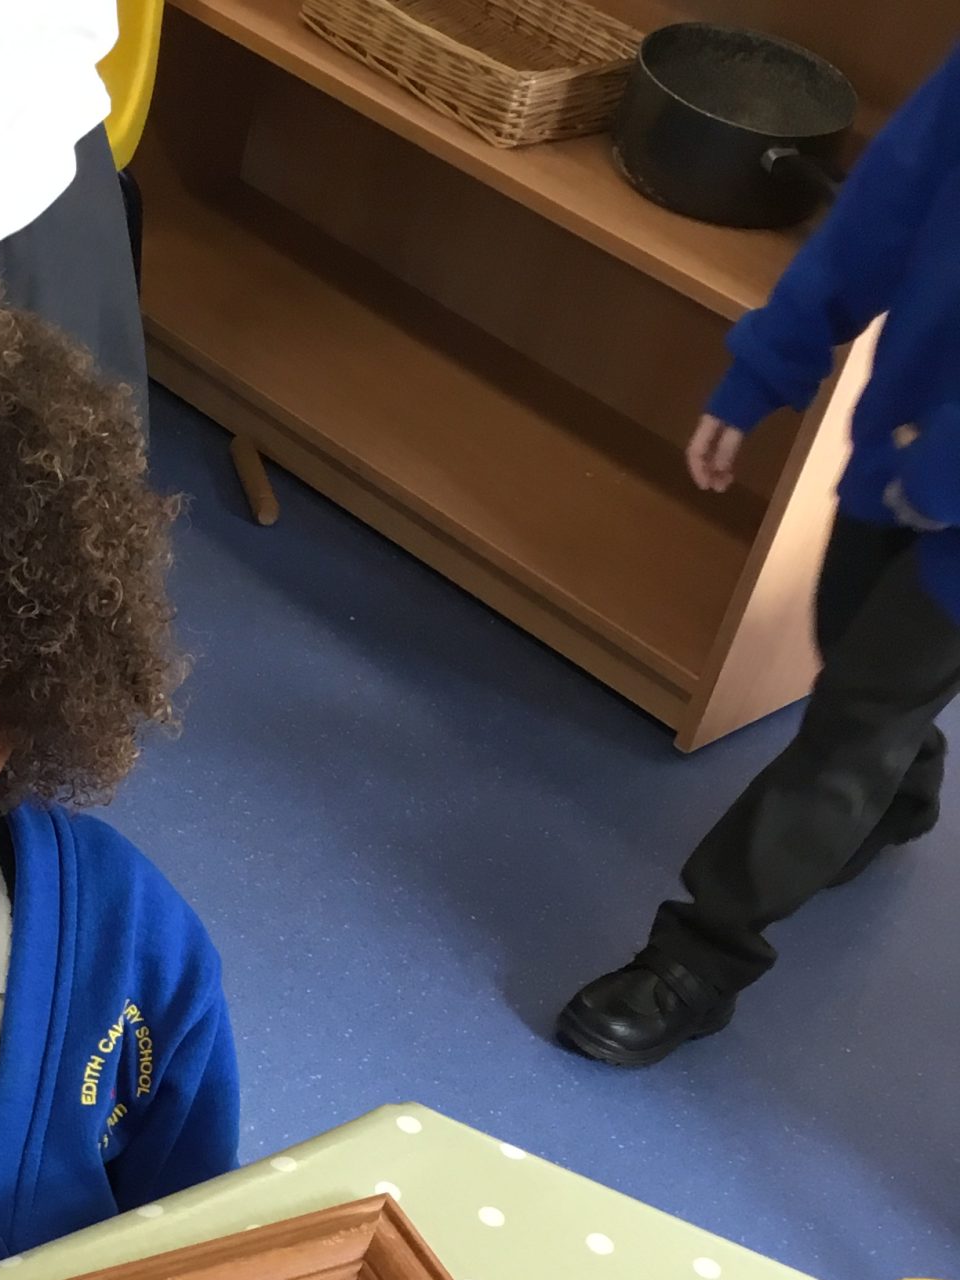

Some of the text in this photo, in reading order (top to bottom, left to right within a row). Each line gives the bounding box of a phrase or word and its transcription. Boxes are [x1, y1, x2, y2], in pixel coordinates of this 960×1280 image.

[81, 1055, 106, 1105] EDITH
[98, 1014, 125, 1053] CAV
[135, 1026, 153, 1097] SCHOOL
